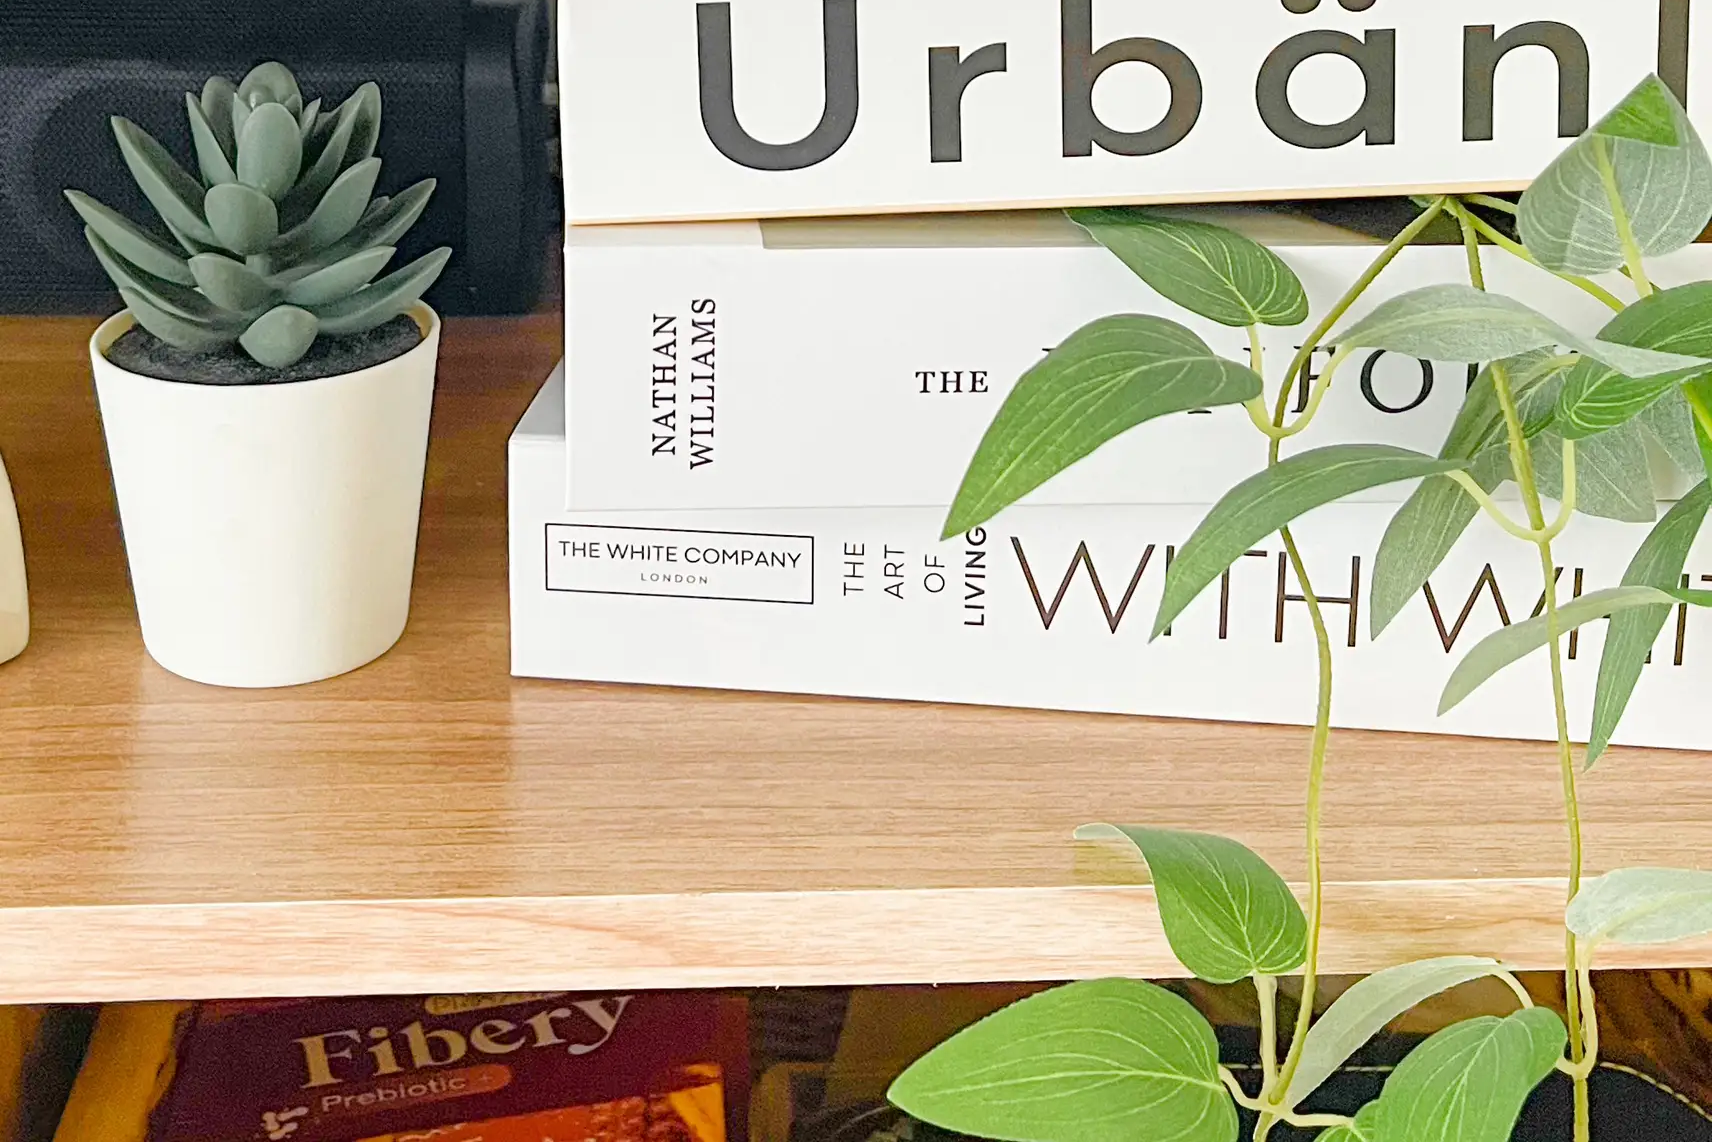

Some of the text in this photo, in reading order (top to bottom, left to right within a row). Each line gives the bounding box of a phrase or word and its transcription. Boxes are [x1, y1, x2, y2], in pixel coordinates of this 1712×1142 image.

[651, 313, 677, 457] NATHAN
[689, 298, 716, 470] WILLIAMS
[915, 370, 989, 394] THE
[558, 540, 802, 569] THE WHITE COMPANY
[640, 572, 708, 585] LONDON
[843, 542, 865, 596] THE
[884, 545, 905, 600] ART
[923, 554, 946, 594] OF
[963, 526, 987, 626] LIVING
[293, 994, 634, 1089] Fibery
[321, 1076, 467, 1113] Prebiotic
